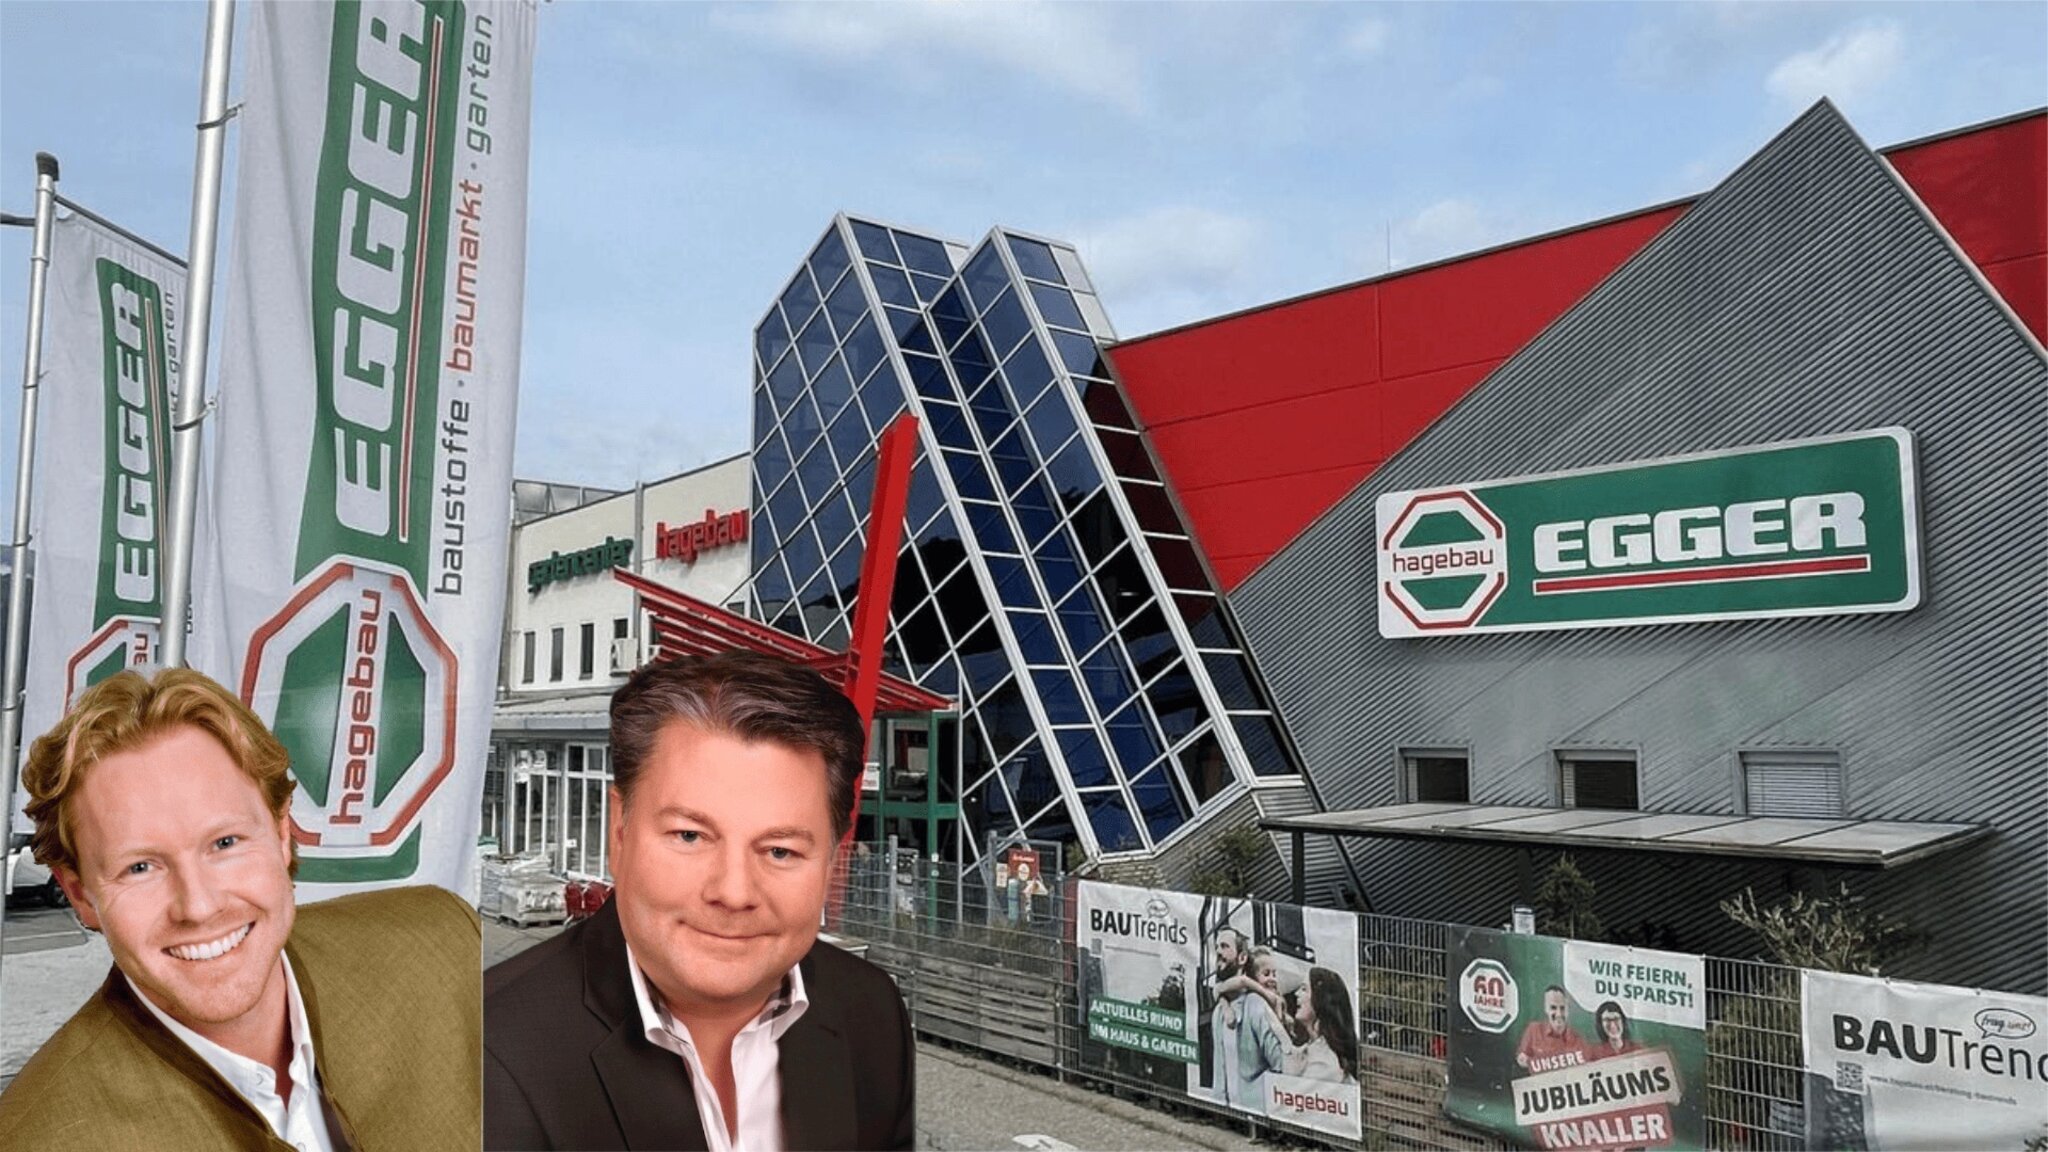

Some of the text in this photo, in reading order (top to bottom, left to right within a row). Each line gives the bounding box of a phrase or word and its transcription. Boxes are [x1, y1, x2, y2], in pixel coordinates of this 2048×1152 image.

[333, 0, 426, 537] EGGER
[434, 15, 492, 597] baustoffe baumarkt garten
[111, 281, 155, 602] EGGER
[656, 509, 750, 563] hagebau
[1534, 491, 1867, 573] EGGER
[1392, 546, 1494, 575] hagebau
[329, 589, 382, 825] hagebau
[1090, 908, 1188, 945] BAUTrends
[1589, 959, 1692, 989] WIR FEIERN,
[1595, 979, 1693, 1008] DU SPARST!
[1090, 1000, 1182, 1031] AKTUELLES RUND
[1141, 1035, 1149, 1049] &
[1151, 1038, 1197, 1059] GARTEN
[1530, 1050, 1585, 1072] UNSERE
[1273, 1086, 1348, 1116] hagebau
[1521, 1066, 1671, 1115] JUBILÄUMS
[1540, 1114, 1667, 1148] KNALLER
